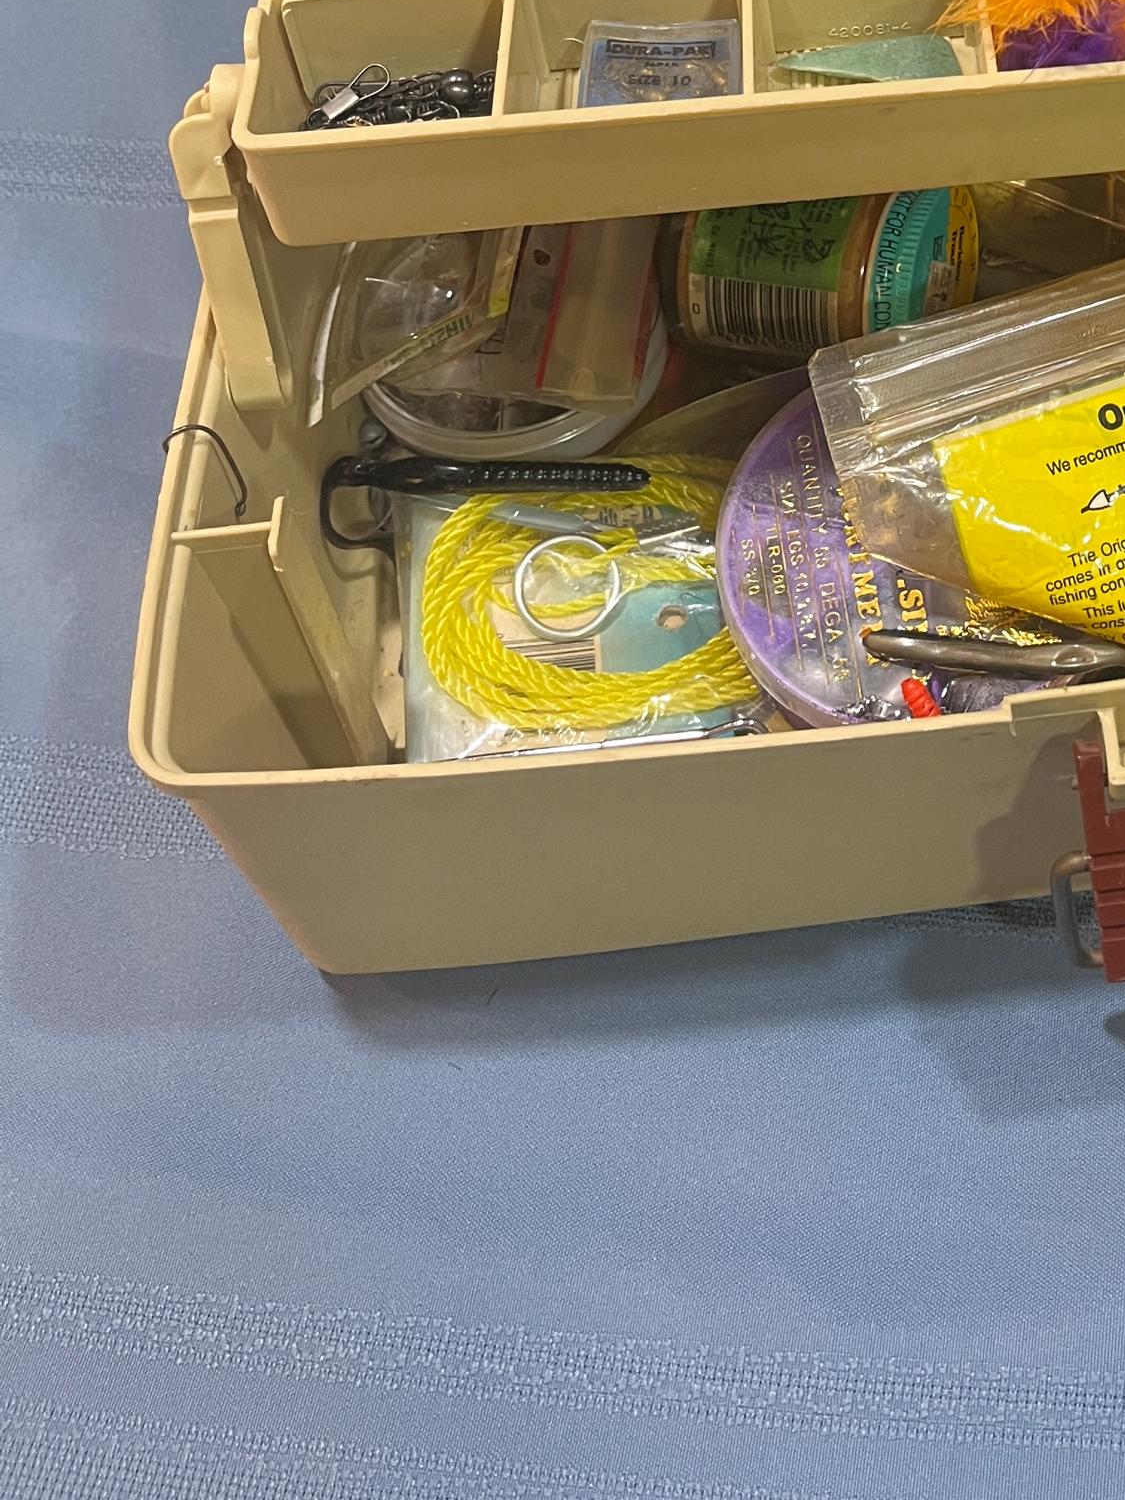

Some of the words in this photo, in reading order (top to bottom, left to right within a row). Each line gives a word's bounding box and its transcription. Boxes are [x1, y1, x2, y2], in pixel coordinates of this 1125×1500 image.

[610, 42, 714, 58] DURA-PAK
[628, 74, 661, 86] SIZE
[672, 75, 692, 86] 10
[883, 211, 907, 237] FOR
[876, 238, 900, 297] HUMAN
[1046, 459, 1071, 476] We
[797, 435, 829, 535] QUANTITY
[1068, 549, 1097, 568] The
[1045, 569, 1095, 592] comes
[1099, 562, 1112, 576] in
[1049, 581, 1098, 607] fishing
[1082, 604, 1115, 622] This
